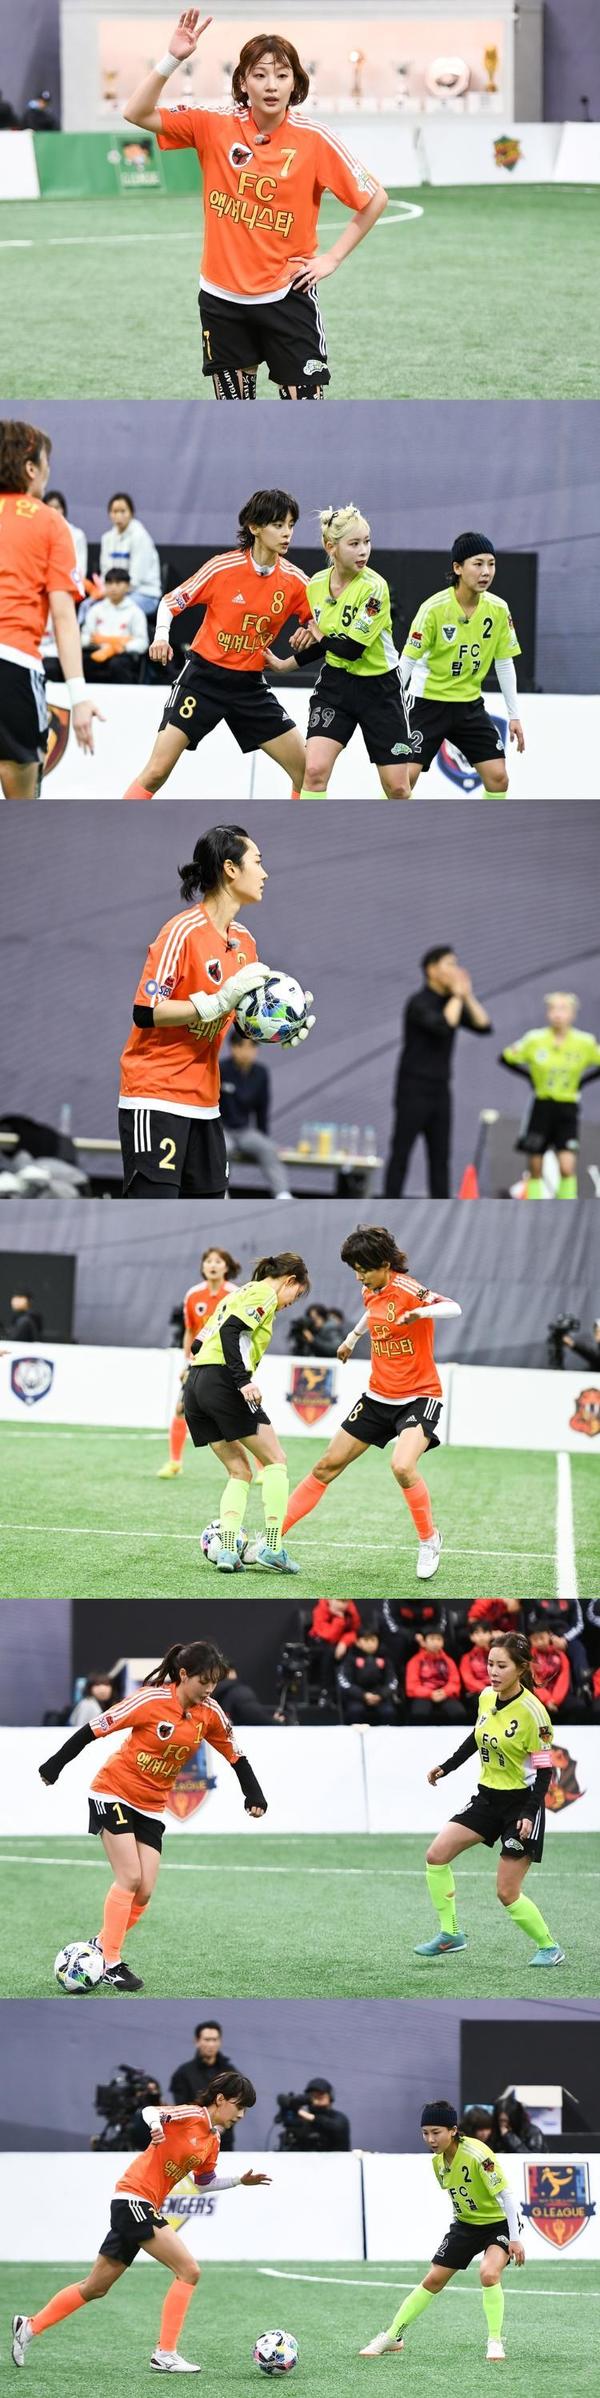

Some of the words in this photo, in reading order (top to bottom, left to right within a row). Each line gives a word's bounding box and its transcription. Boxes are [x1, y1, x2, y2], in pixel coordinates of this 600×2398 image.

[280, 147, 297, 177] 7
[237, 171, 278, 202] FC
[208, 189, 295, 238] 액셔니스타
[203, 330, 213, 361] 7
[271, 590, 286, 615] 8
[241, 614, 271, 634] FC
[482, 616, 493, 639] 2
[179, 695, 197, 719] 8
[310, 706, 335, 728] 59
[411, 730, 423, 753] 2
[159, 1137, 176, 1170] 2
[386, 1302, 395, 1322] 8
[349, 1402, 363, 1421] 8
[194, 1722, 203, 1744] 1
[505, 1720, 518, 1738] 3
[162, 1744, 190, 1761] FC
[112, 1802, 128, 1825] 1
[462, 2165, 472, 2183] 2
[543, 2206, 585, 2217] LEAGUE
[436, 2238, 449, 2257] 2
